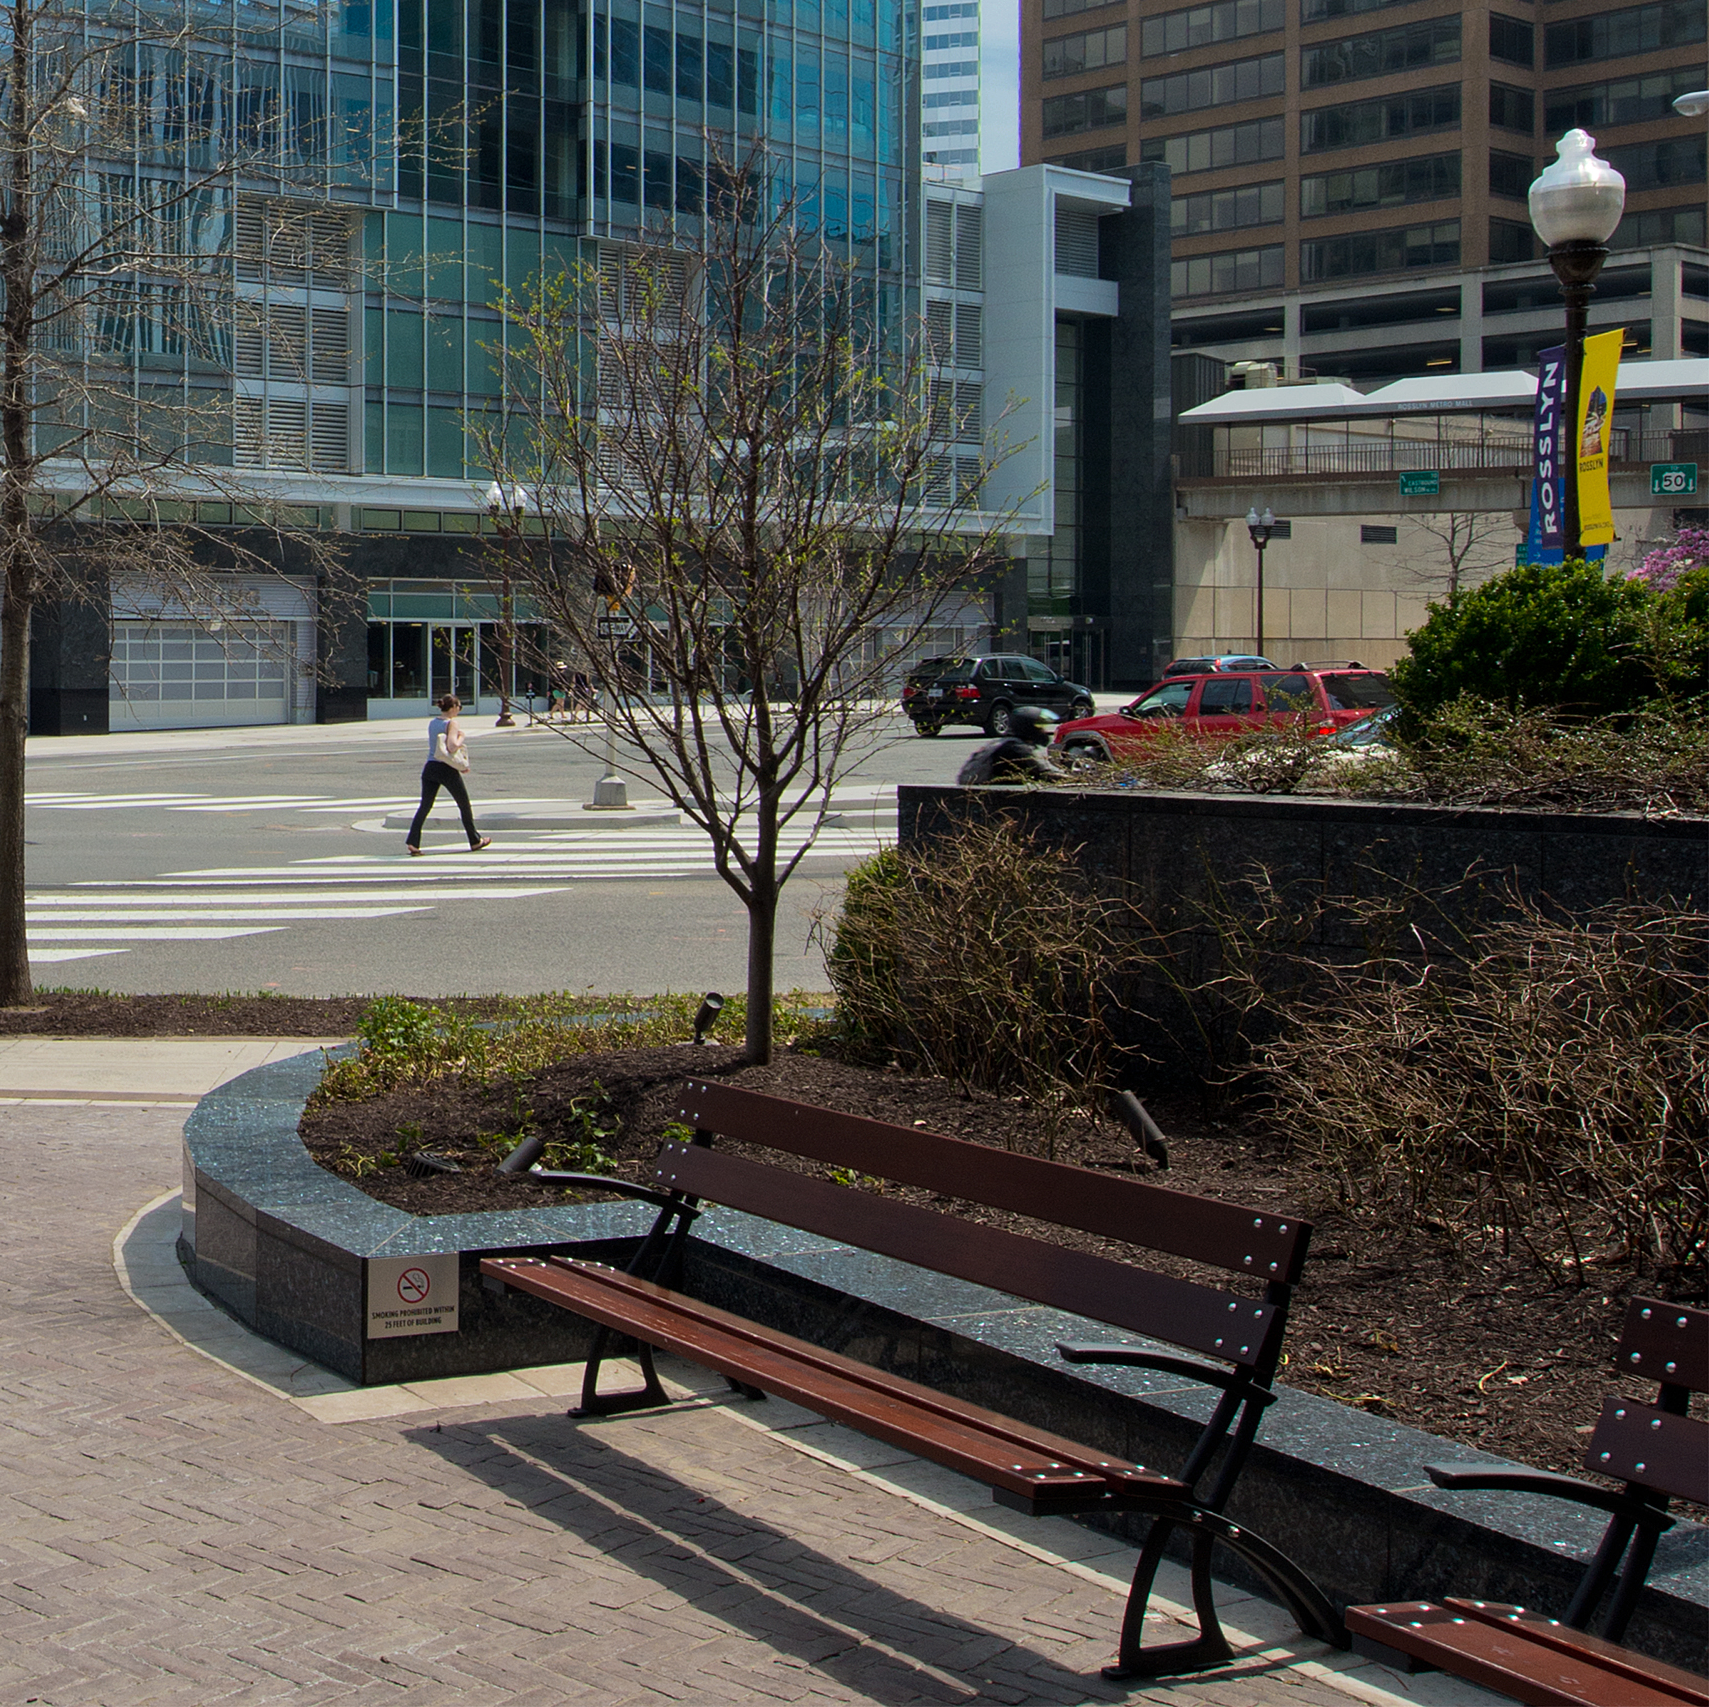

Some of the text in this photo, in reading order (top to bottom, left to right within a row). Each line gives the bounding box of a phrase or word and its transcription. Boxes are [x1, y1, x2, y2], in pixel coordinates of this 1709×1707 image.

[1397, 399, 1473, 411] ROSSLYN METRO MALL
[1539, 362, 1559, 533] ROSSLYN
[1579, 457, 1604, 474] ROSSLYN
[1663, 475, 1683, 487] 50
[372, 1305, 455, 1320] SMOKING PROHIBITED WITHIN
[385, 1316, 442, 1329] 25 FEET OF BUILDING
